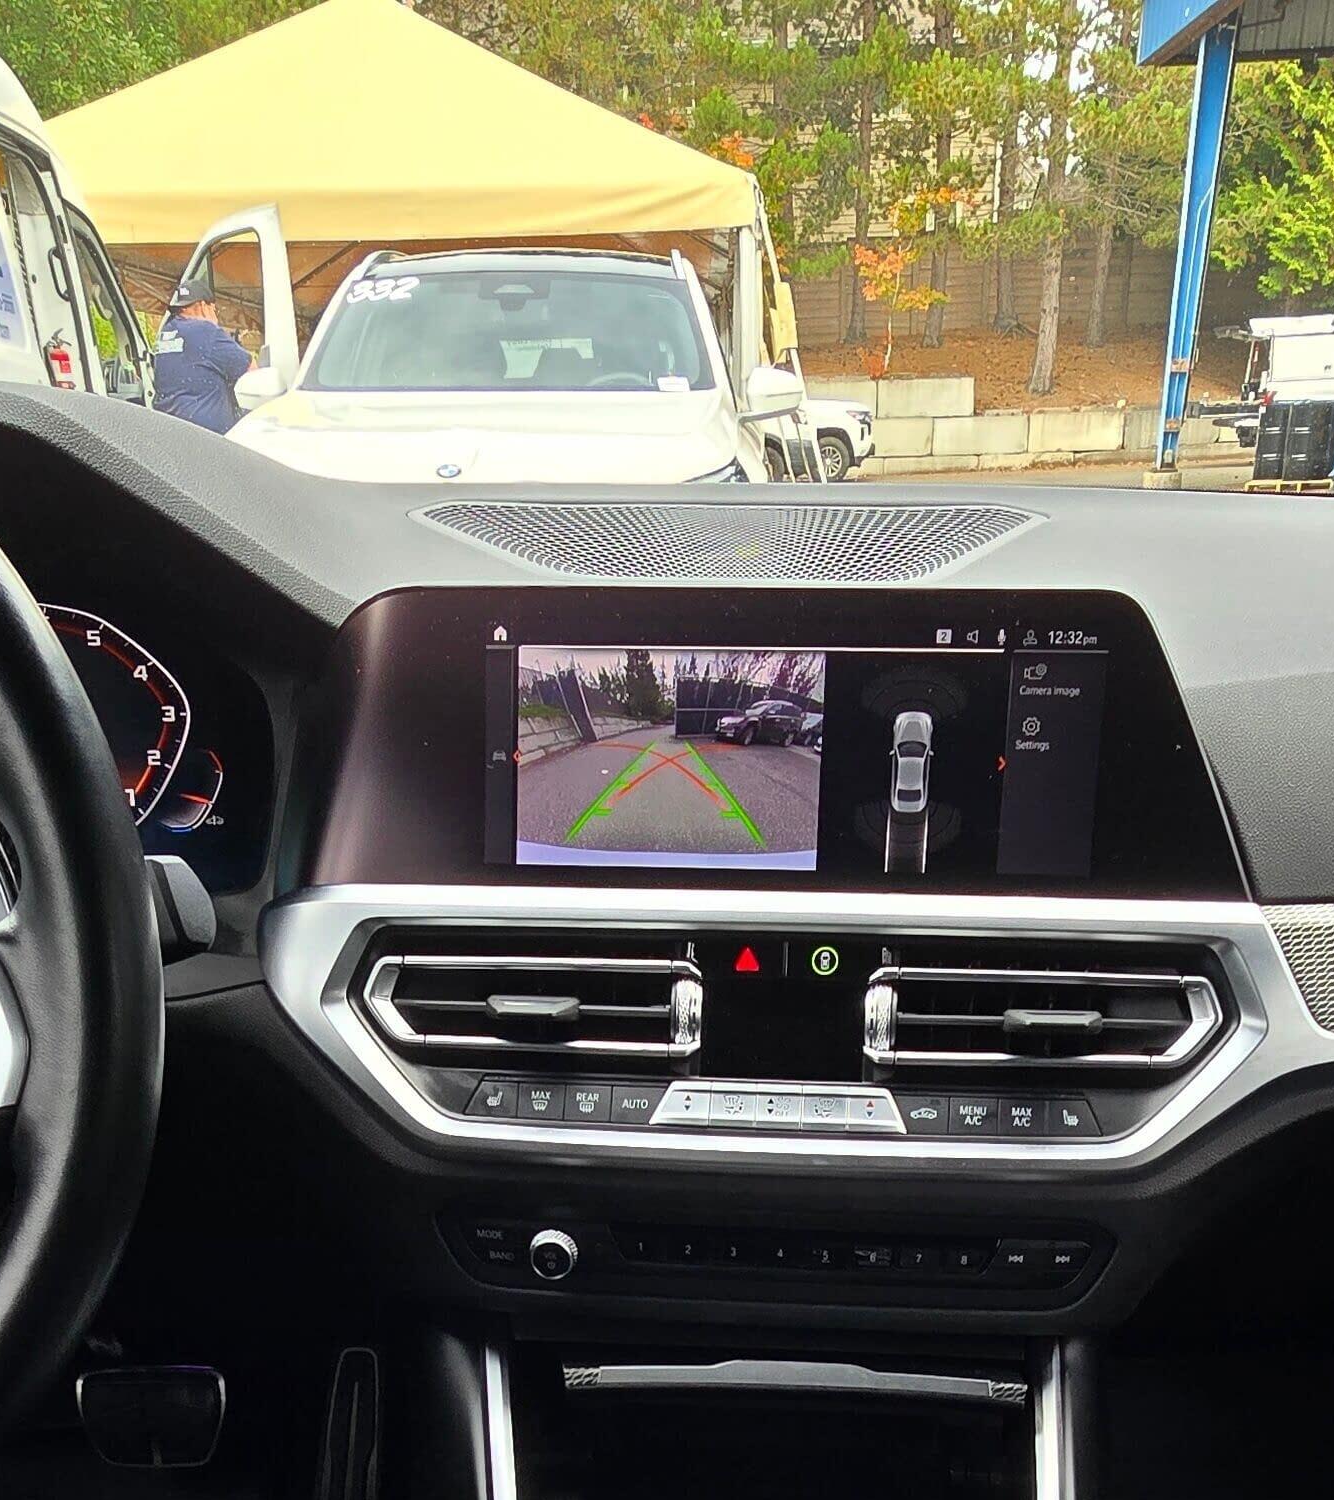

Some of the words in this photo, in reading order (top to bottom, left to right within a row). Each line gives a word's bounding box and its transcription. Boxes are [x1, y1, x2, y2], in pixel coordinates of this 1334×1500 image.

[347, 276, 420, 304] 332
[86, 630, 101, 646] 5
[133, 665, 148, 681] 4
[1019, 685, 1051, 696] Camera
[1054, 685, 1080, 697] image
[161, 706, 176, 722] 3
[1015, 740, 1050, 751] Settings
[147, 749, 161, 766] 2
[124, 788, 136, 807] 1
[531, 1091, 551, 1100] MAX
[576, 1093, 599, 1103] REAR
[622, 1099, 649, 1110] AUTO
[959, 1105, 987, 1116] MENU
[1011, 1107, 1032, 1117] MAX
[964, 1115, 982, 1126] A/C
[1013, 1116, 1031, 1127] A/C
[477, 1229, 503, 1240] MODE
[490, 1251, 514, 1261] BAND
